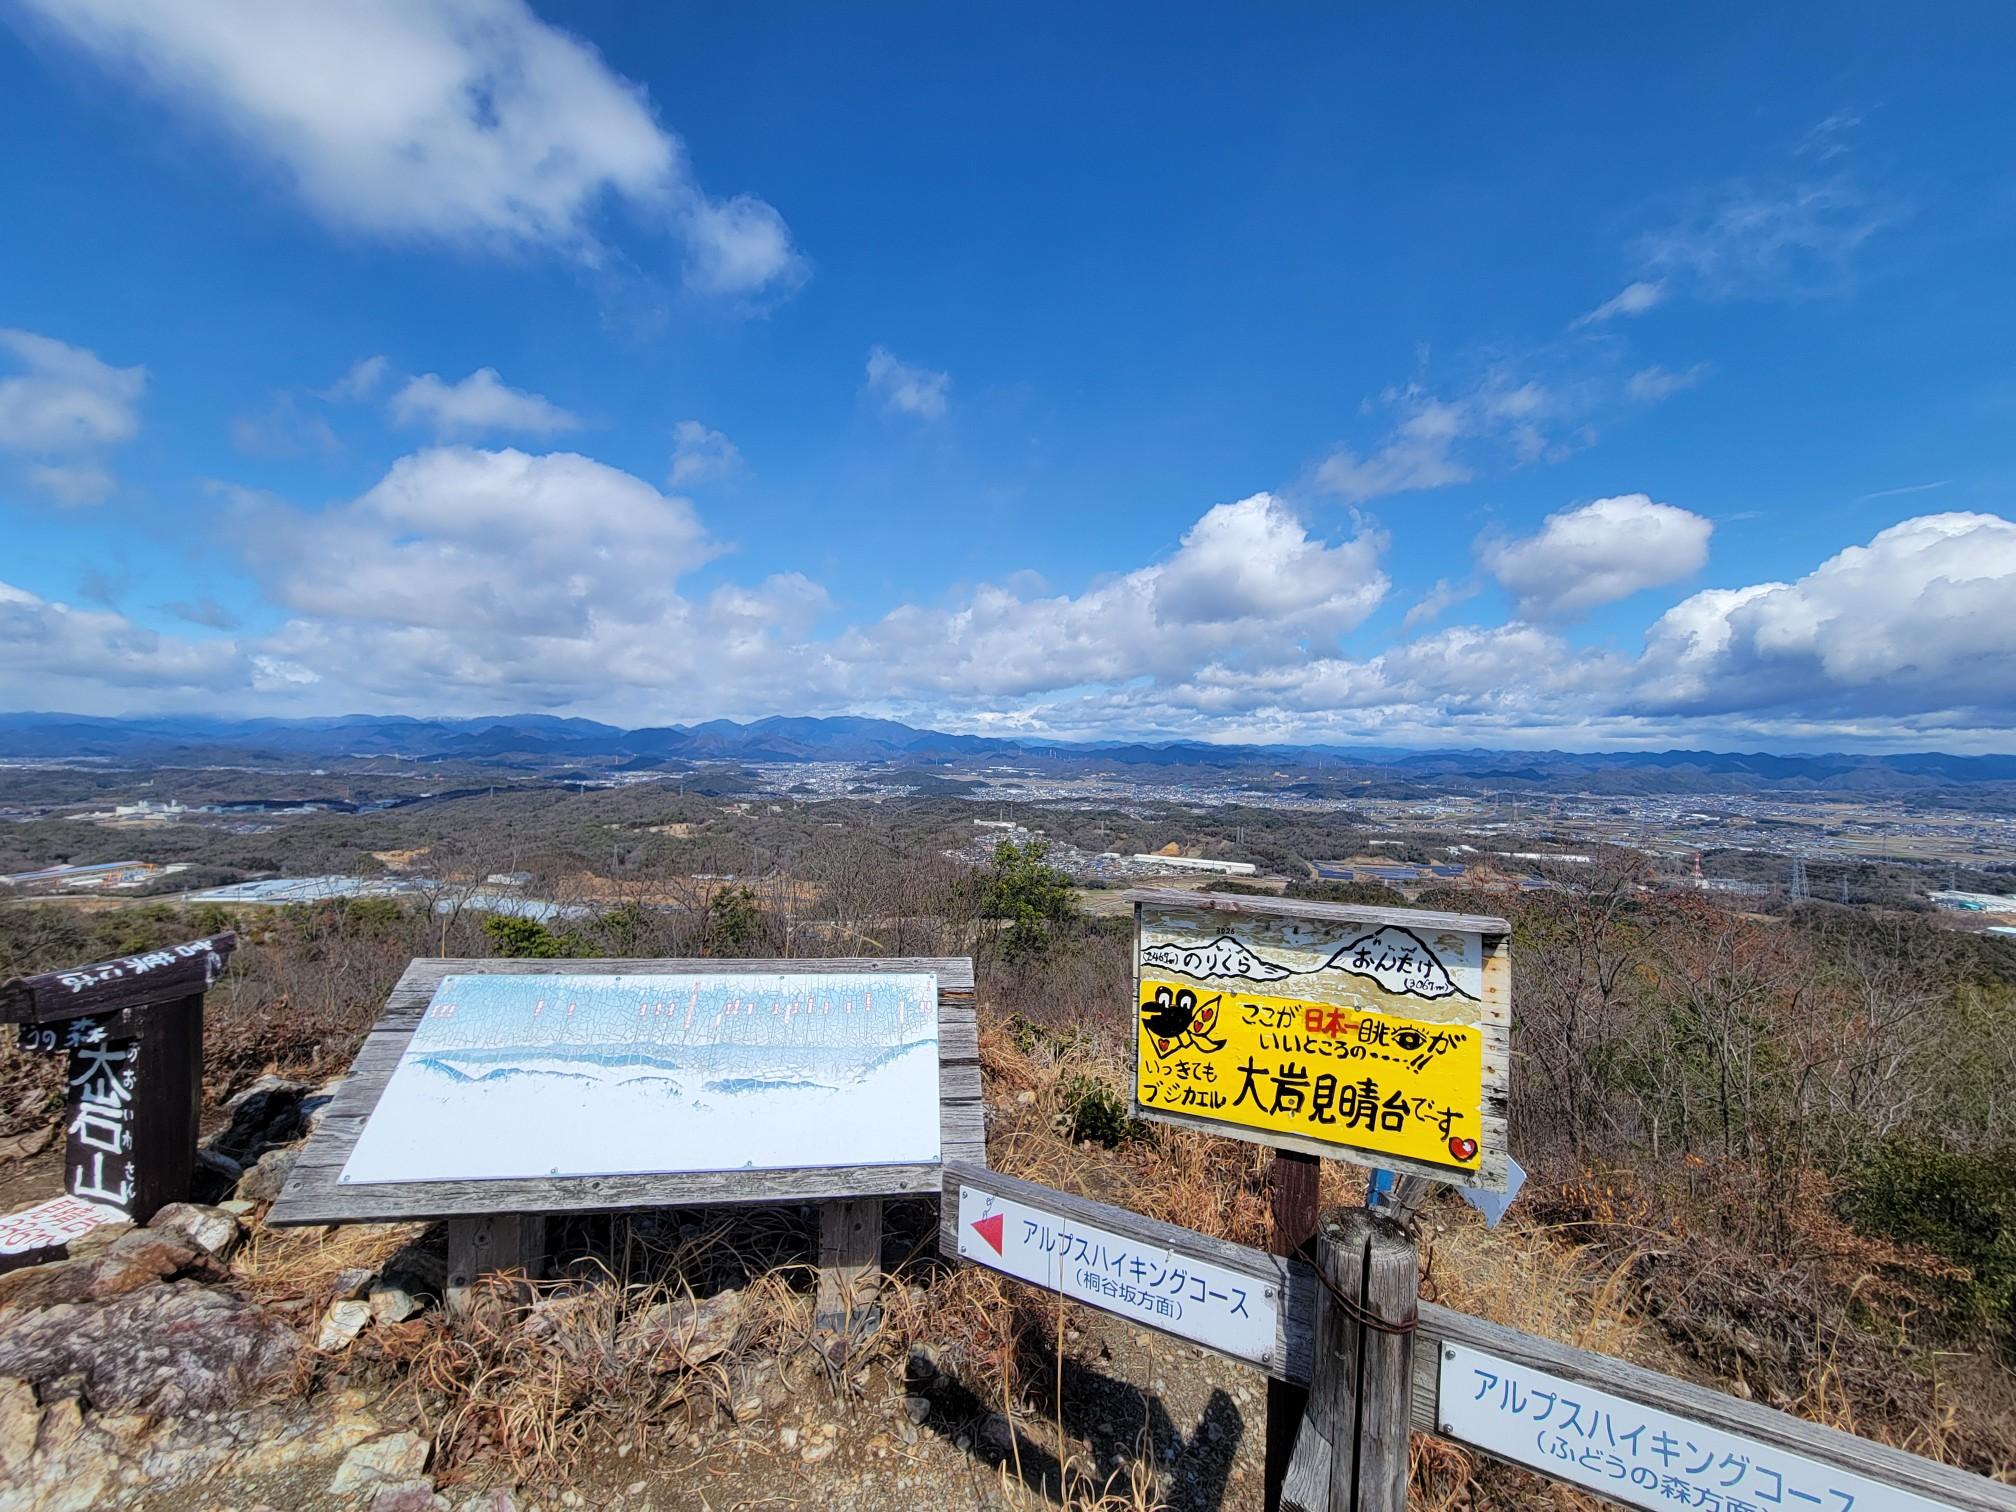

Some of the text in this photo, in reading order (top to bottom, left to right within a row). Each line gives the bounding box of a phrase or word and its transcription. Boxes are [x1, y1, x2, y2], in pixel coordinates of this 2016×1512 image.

[1216, 926, 1236, 935] 3026
[1183, 952, 1251, 974] のりくら
[1352, 946, 1435, 979] おんたけ
[68, 1041, 132, 1206] 大岩山
[1023, 1220, 1250, 1319] アルプスハイキングコース
